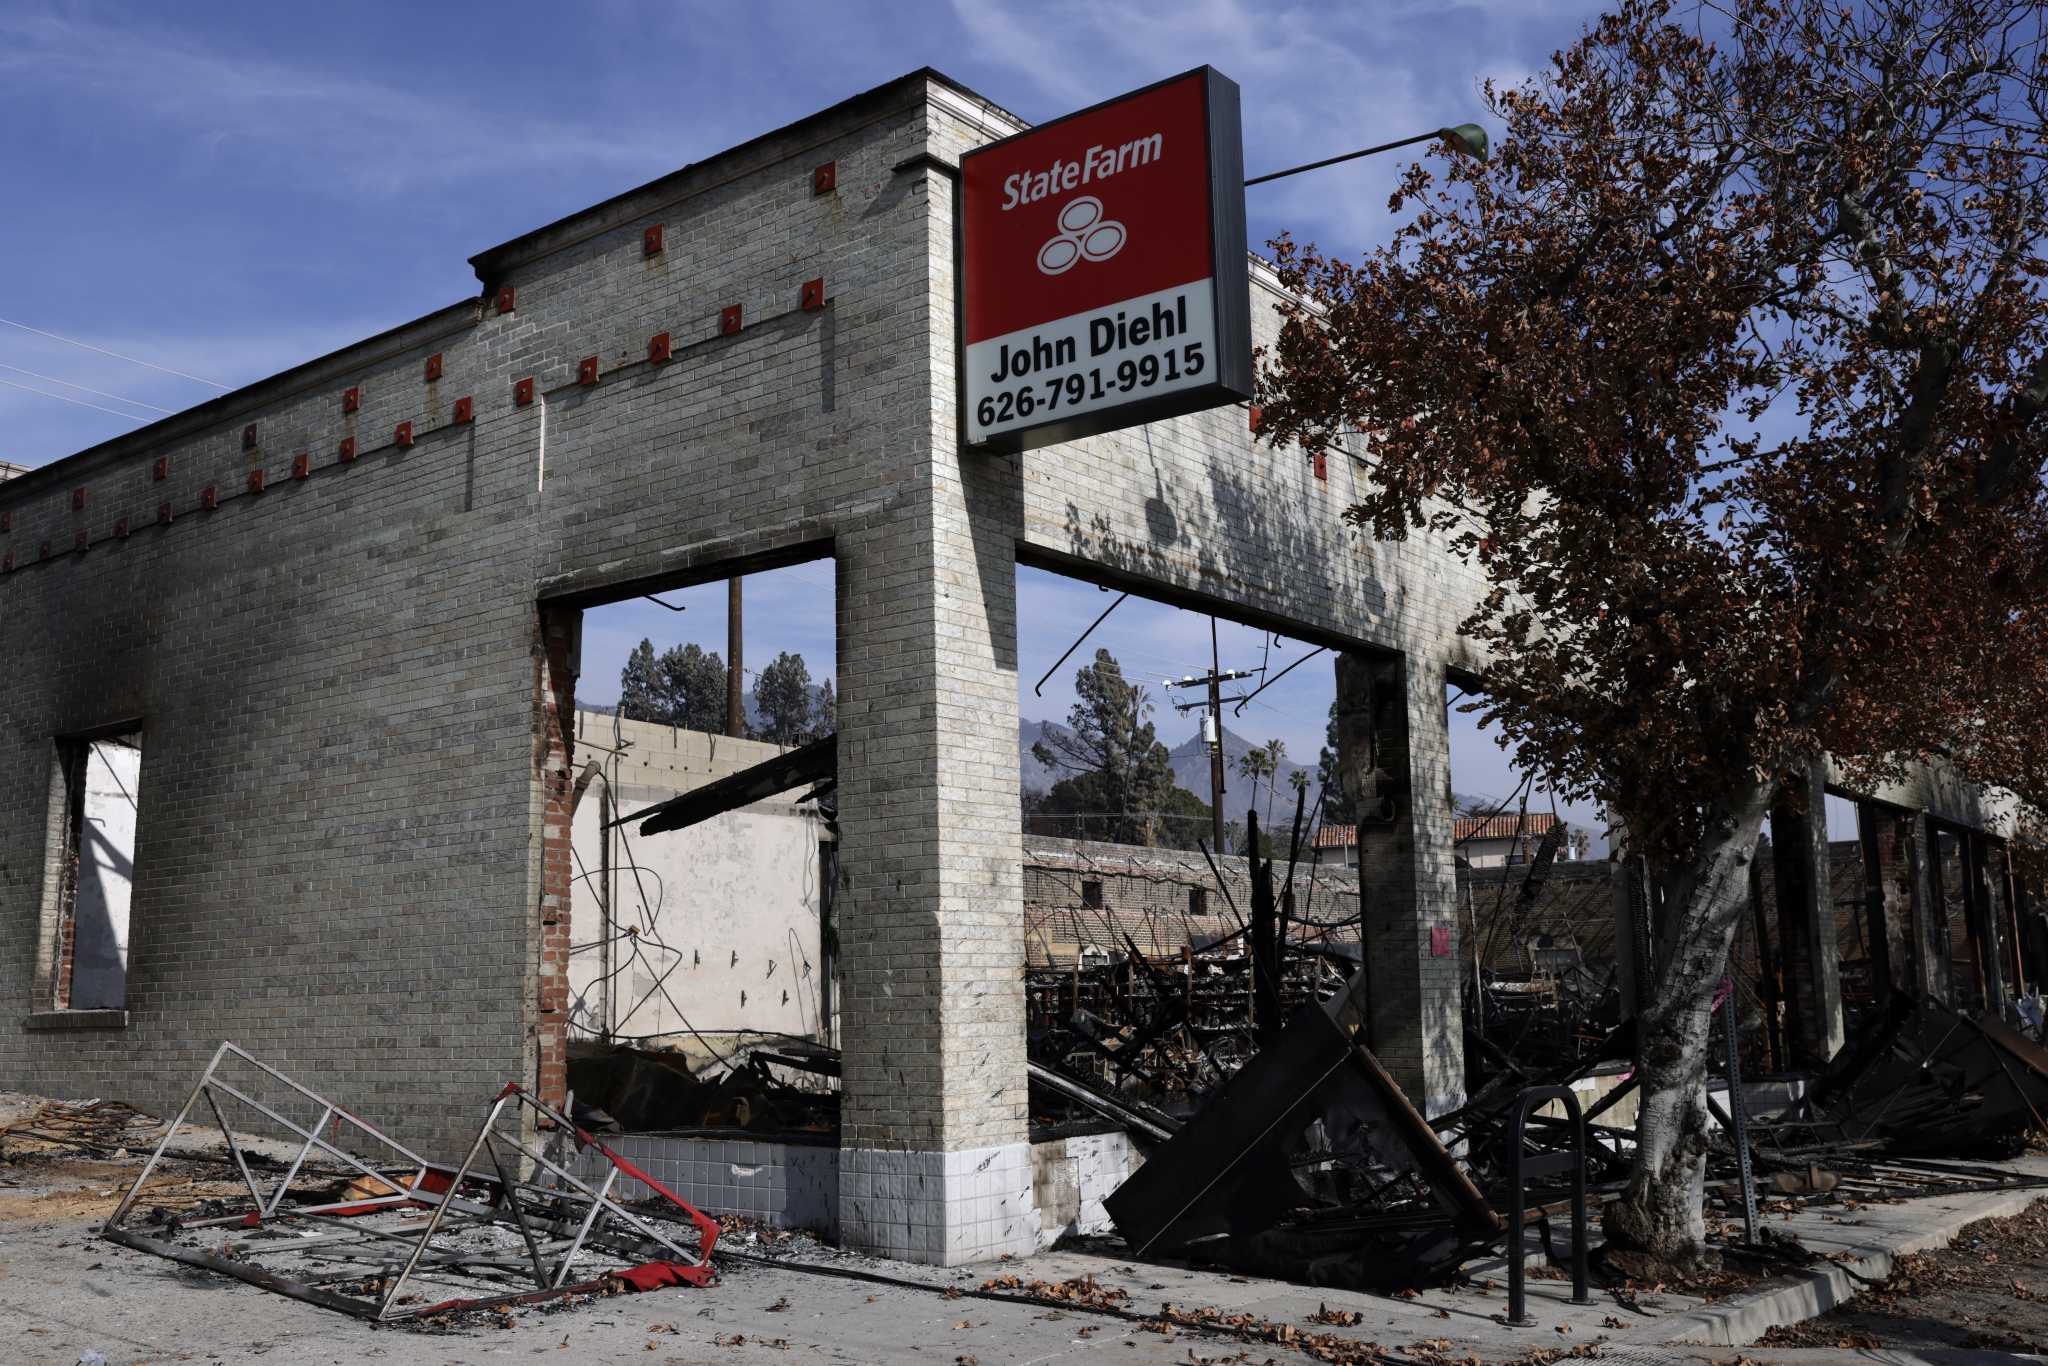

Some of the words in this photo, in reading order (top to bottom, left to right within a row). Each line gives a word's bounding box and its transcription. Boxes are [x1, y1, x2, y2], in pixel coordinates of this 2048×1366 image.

[990, 335, 1076, 384] John
[1089, 295, 1188, 358] Diehl
[977, 341, 1206, 427] 626-791-9915
